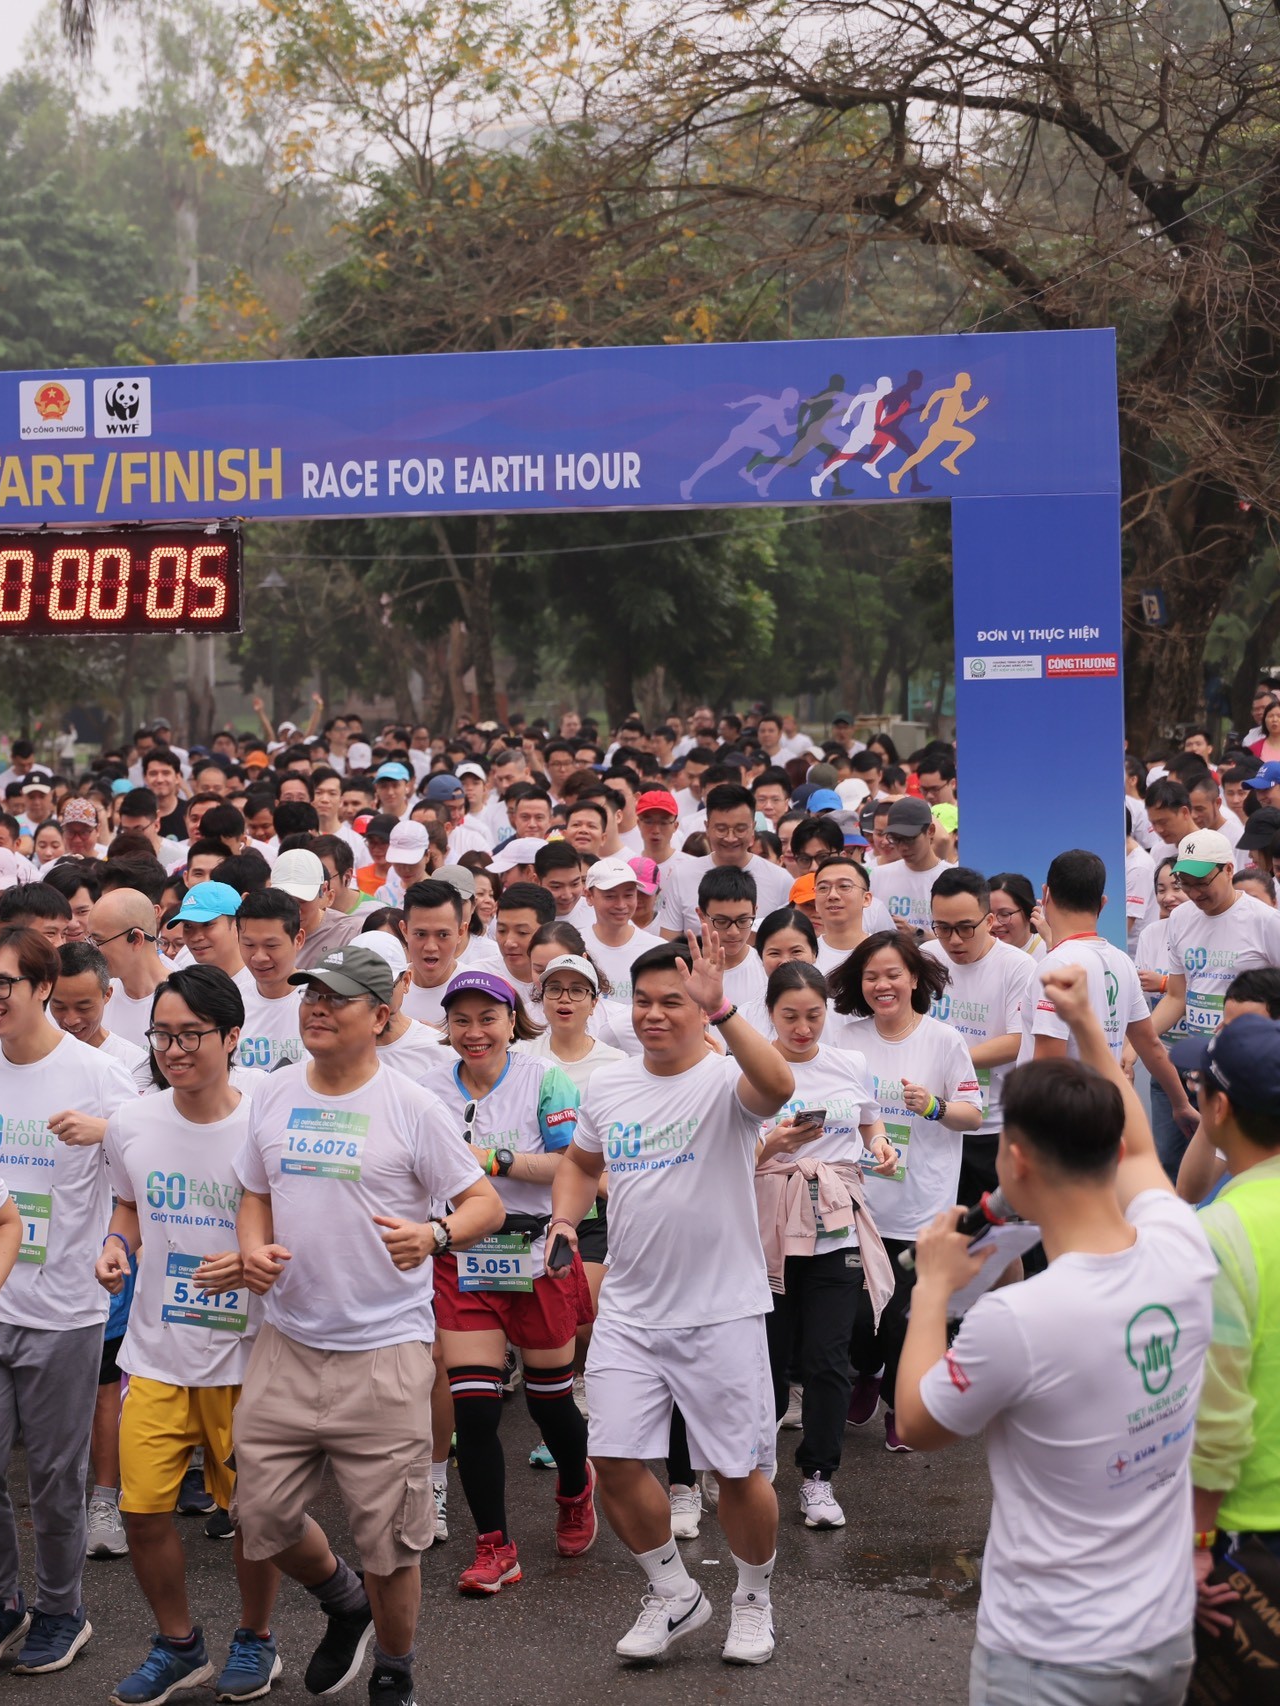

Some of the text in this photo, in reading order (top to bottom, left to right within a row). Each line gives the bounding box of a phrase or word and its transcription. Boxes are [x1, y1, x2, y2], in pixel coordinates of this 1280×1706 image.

[33, 425, 54, 434] CÔNG
[106, 423, 140, 435] WWF
[302, 452, 641, 499] RACE FOR EARTH HOUR
[977, 625, 1099, 644] ĐƠN VỊ THỰC HIỆN
[1184, 947, 1207, 971] 60
[453, 978, 491, 989] LIVWELL
[951, 1009, 985, 1022] HOUR
[952, 999, 989, 1013] EARTH
[1189, 1010, 1220, 1026] 5.617
[240, 1037, 270, 1067] 60
[645, 1117, 699, 1138] EARTH
[5, 1132, 55, 1148] HOUR
[288, 1137, 357, 1158] 16.6078
[608, 1121, 641, 1159] 60
[11, 1154, 29, 1165] ĐẤT
[32, 1156, 55, 1167] 2024
[146, 1171, 186, 1210] 60
[189, 1179, 245, 1200] EARTH
[189, 1194, 236, 1212] HOUR
[151, 1211, 237, 1231] GIỜ TRÁI ĐẤT 202
[467, 1257, 520, 1274] 5.051
[174, 1282, 239, 1309] 5.412
